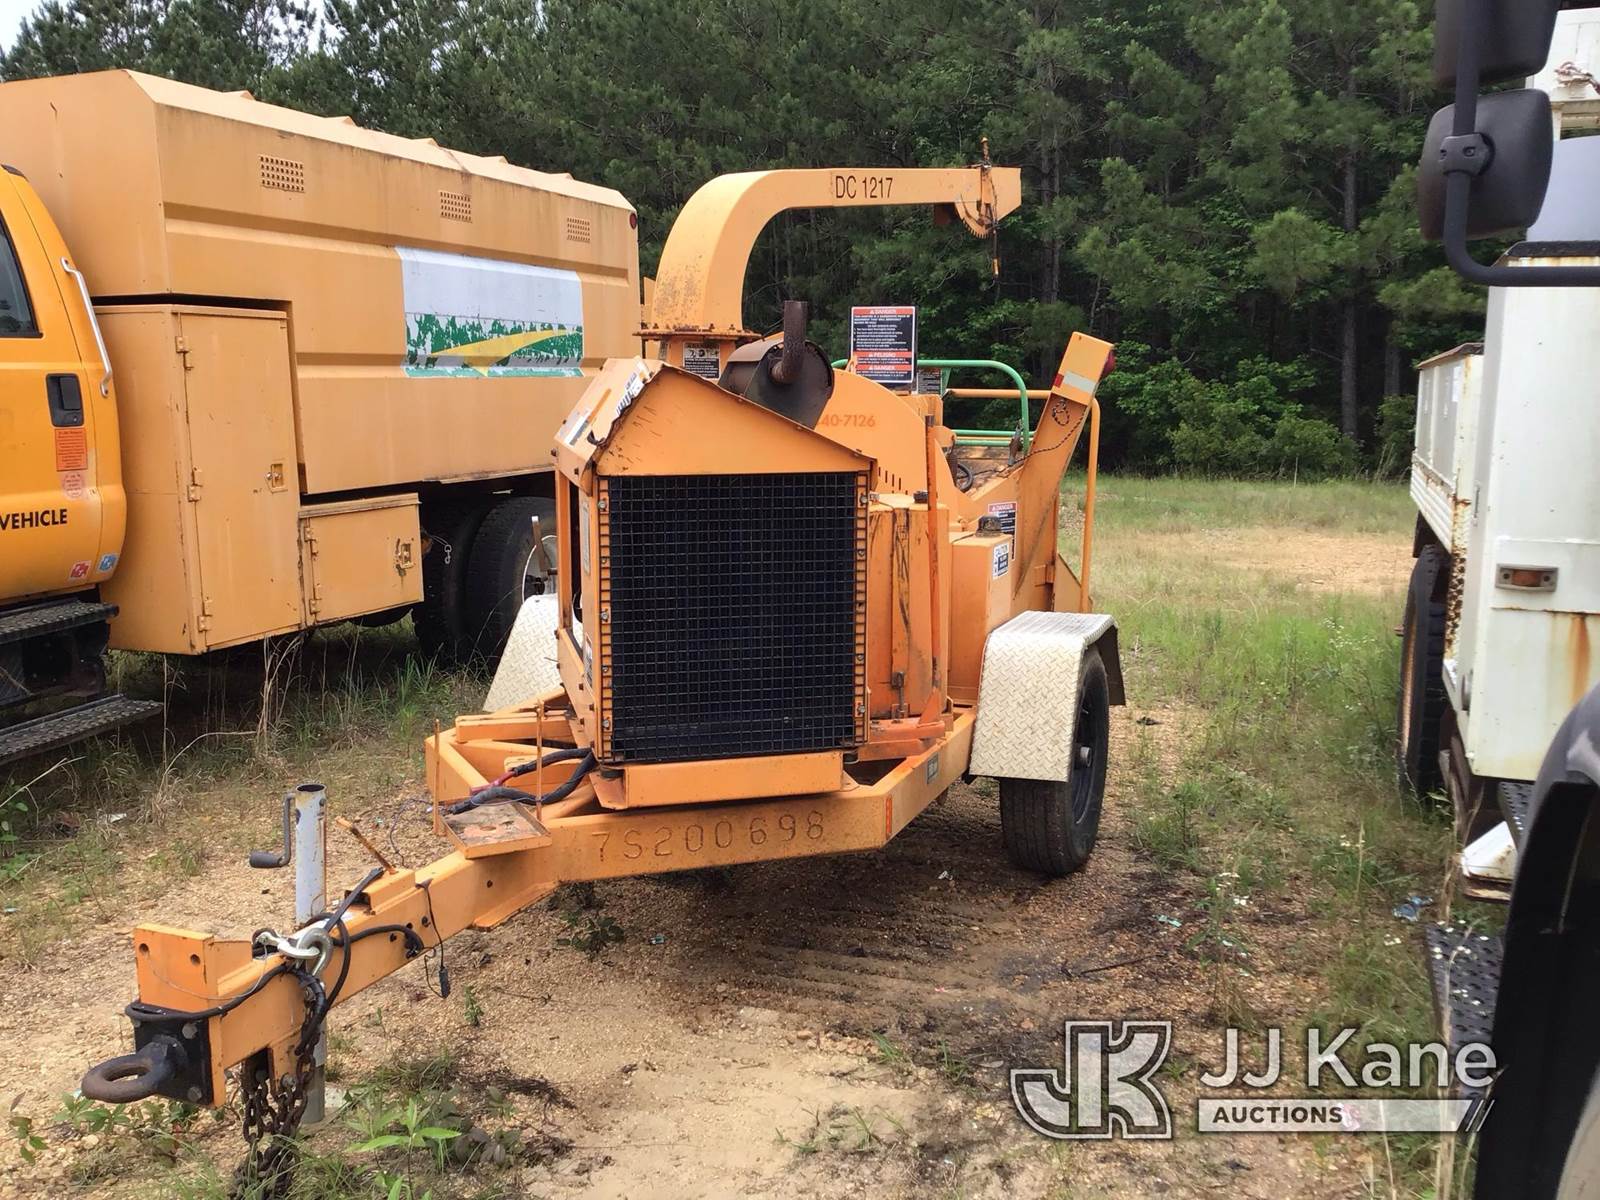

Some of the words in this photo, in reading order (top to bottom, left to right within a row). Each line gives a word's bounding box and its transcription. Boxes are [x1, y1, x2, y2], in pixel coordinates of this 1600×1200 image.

[835, 175, 857, 199] DC
[862, 176, 893, 199] 1217
[0, 508, 68, 530] VEHICLE
